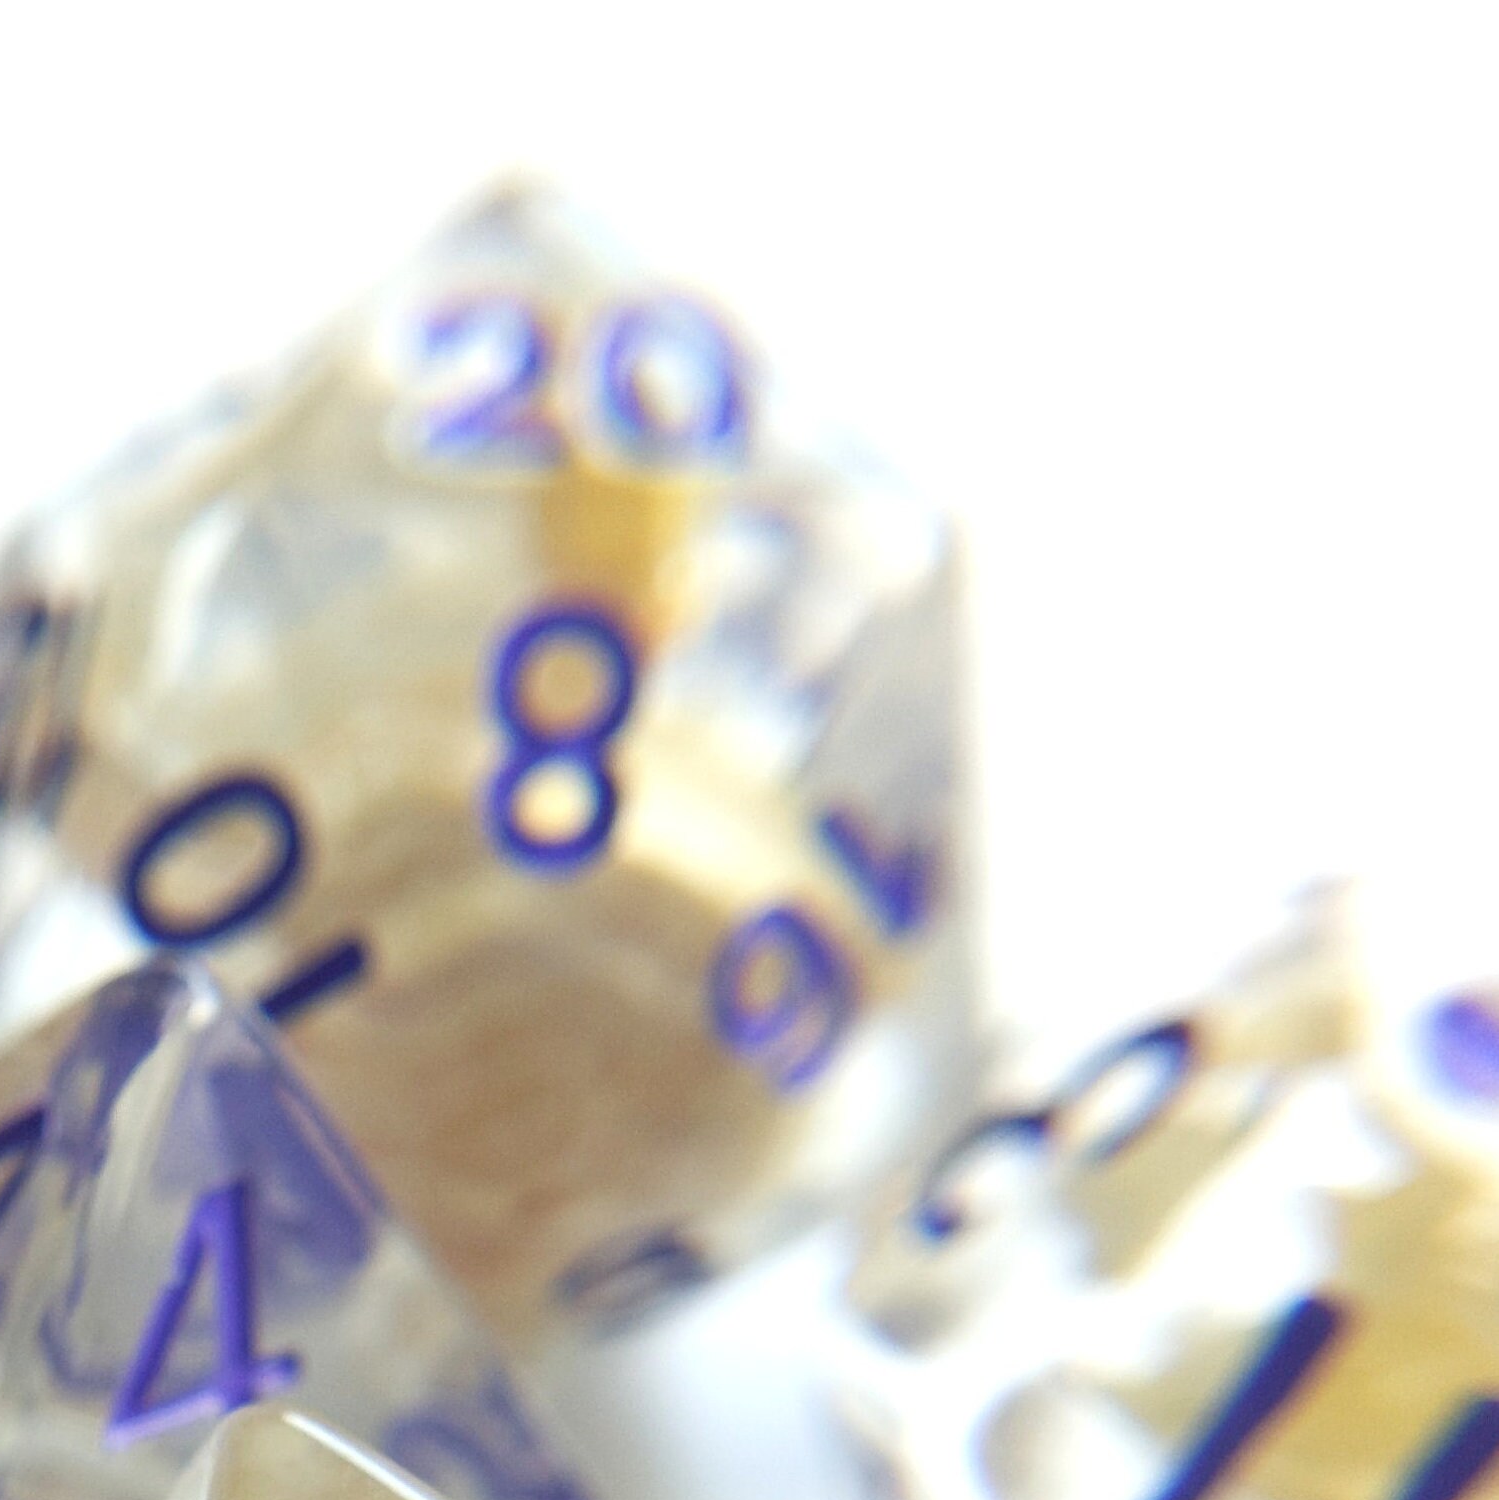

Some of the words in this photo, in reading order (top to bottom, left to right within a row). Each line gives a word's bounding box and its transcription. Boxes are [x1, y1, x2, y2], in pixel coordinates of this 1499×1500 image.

[408, 288, 750, 472] 20
[482, 605, 638, 875] 8
[105, 1178, 303, 1448] 4
